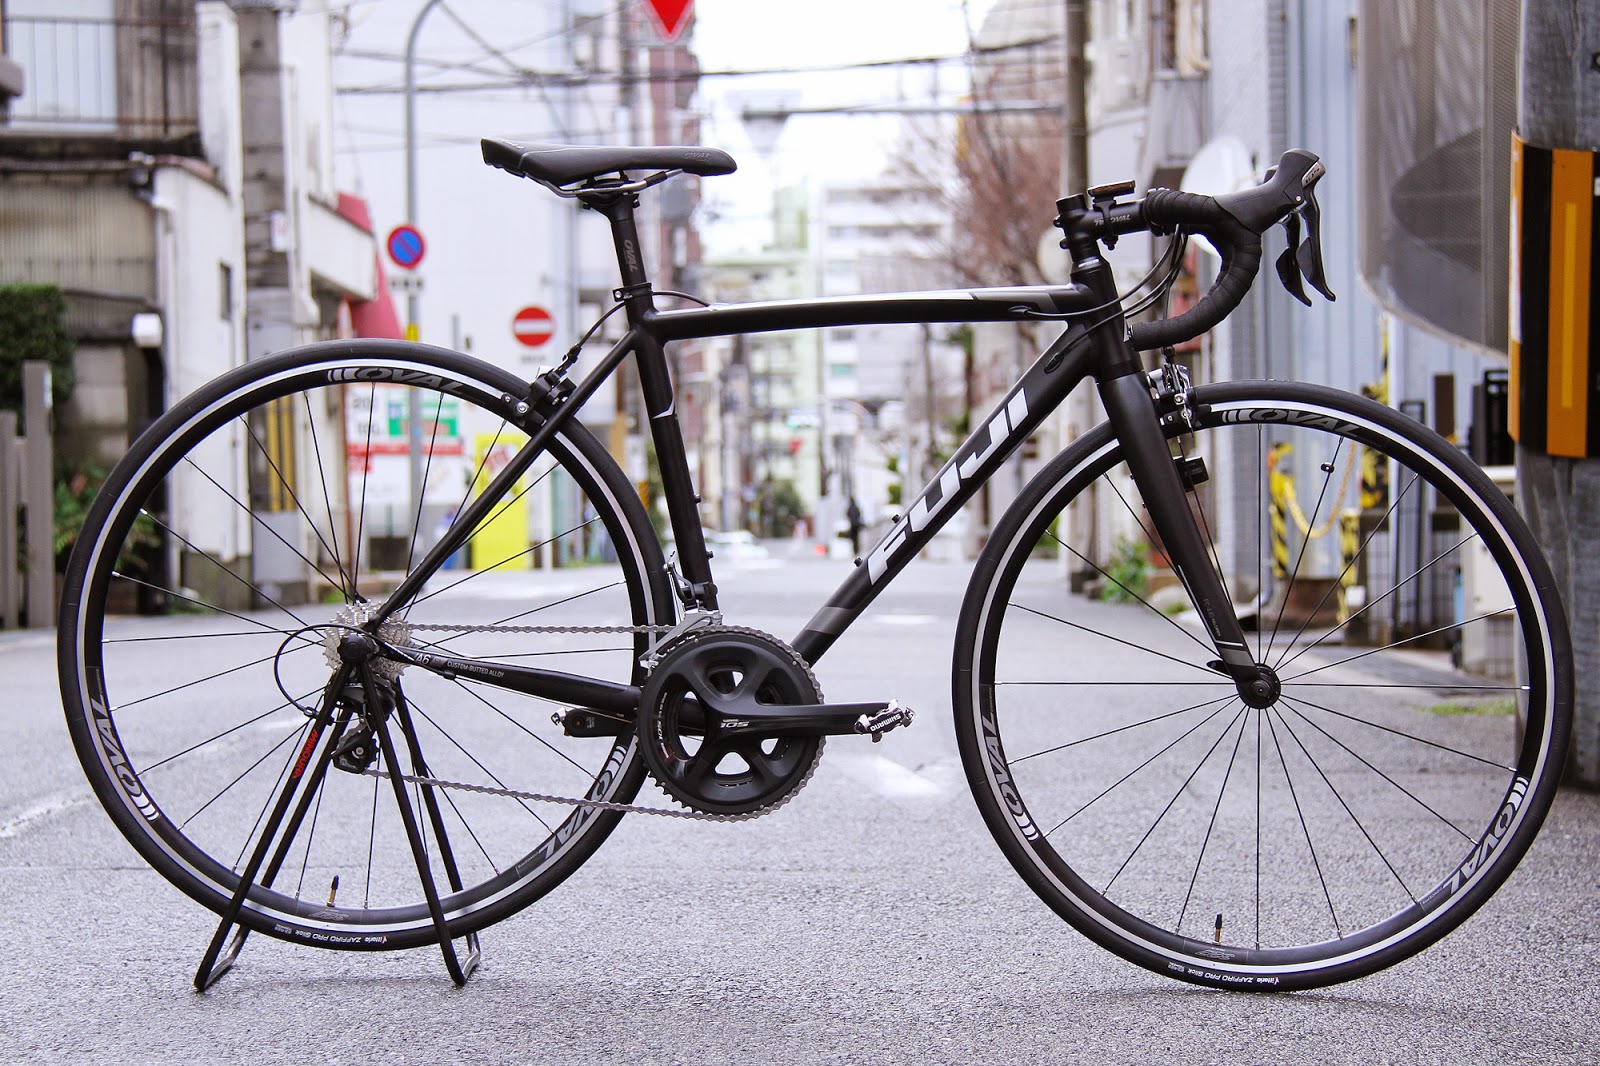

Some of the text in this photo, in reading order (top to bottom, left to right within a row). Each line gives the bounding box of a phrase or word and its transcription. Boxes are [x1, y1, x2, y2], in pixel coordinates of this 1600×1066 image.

[624, 239, 638, 273] OVAL
[356, 367, 463, 394] OVAL
[1251, 408, 1360, 437] OVAL
[867, 387, 1029, 585] FUJI
[488, 670, 505, 678] ALLOY
[870, 713, 901, 732] SHIMANO
[91, 694, 141, 795] OVAL
[292, 728, 319, 778] MINOURA
[982, 712, 1023, 815] OVAL
[1442, 803, 1514, 894] OVAL
[312, 933, 330, 941] PRO
[330, 935, 361, 943] ZAFFIRO
[1204, 972, 1221, 980] PRO
[1222, 974, 1254, 983] ZAFFIRO
